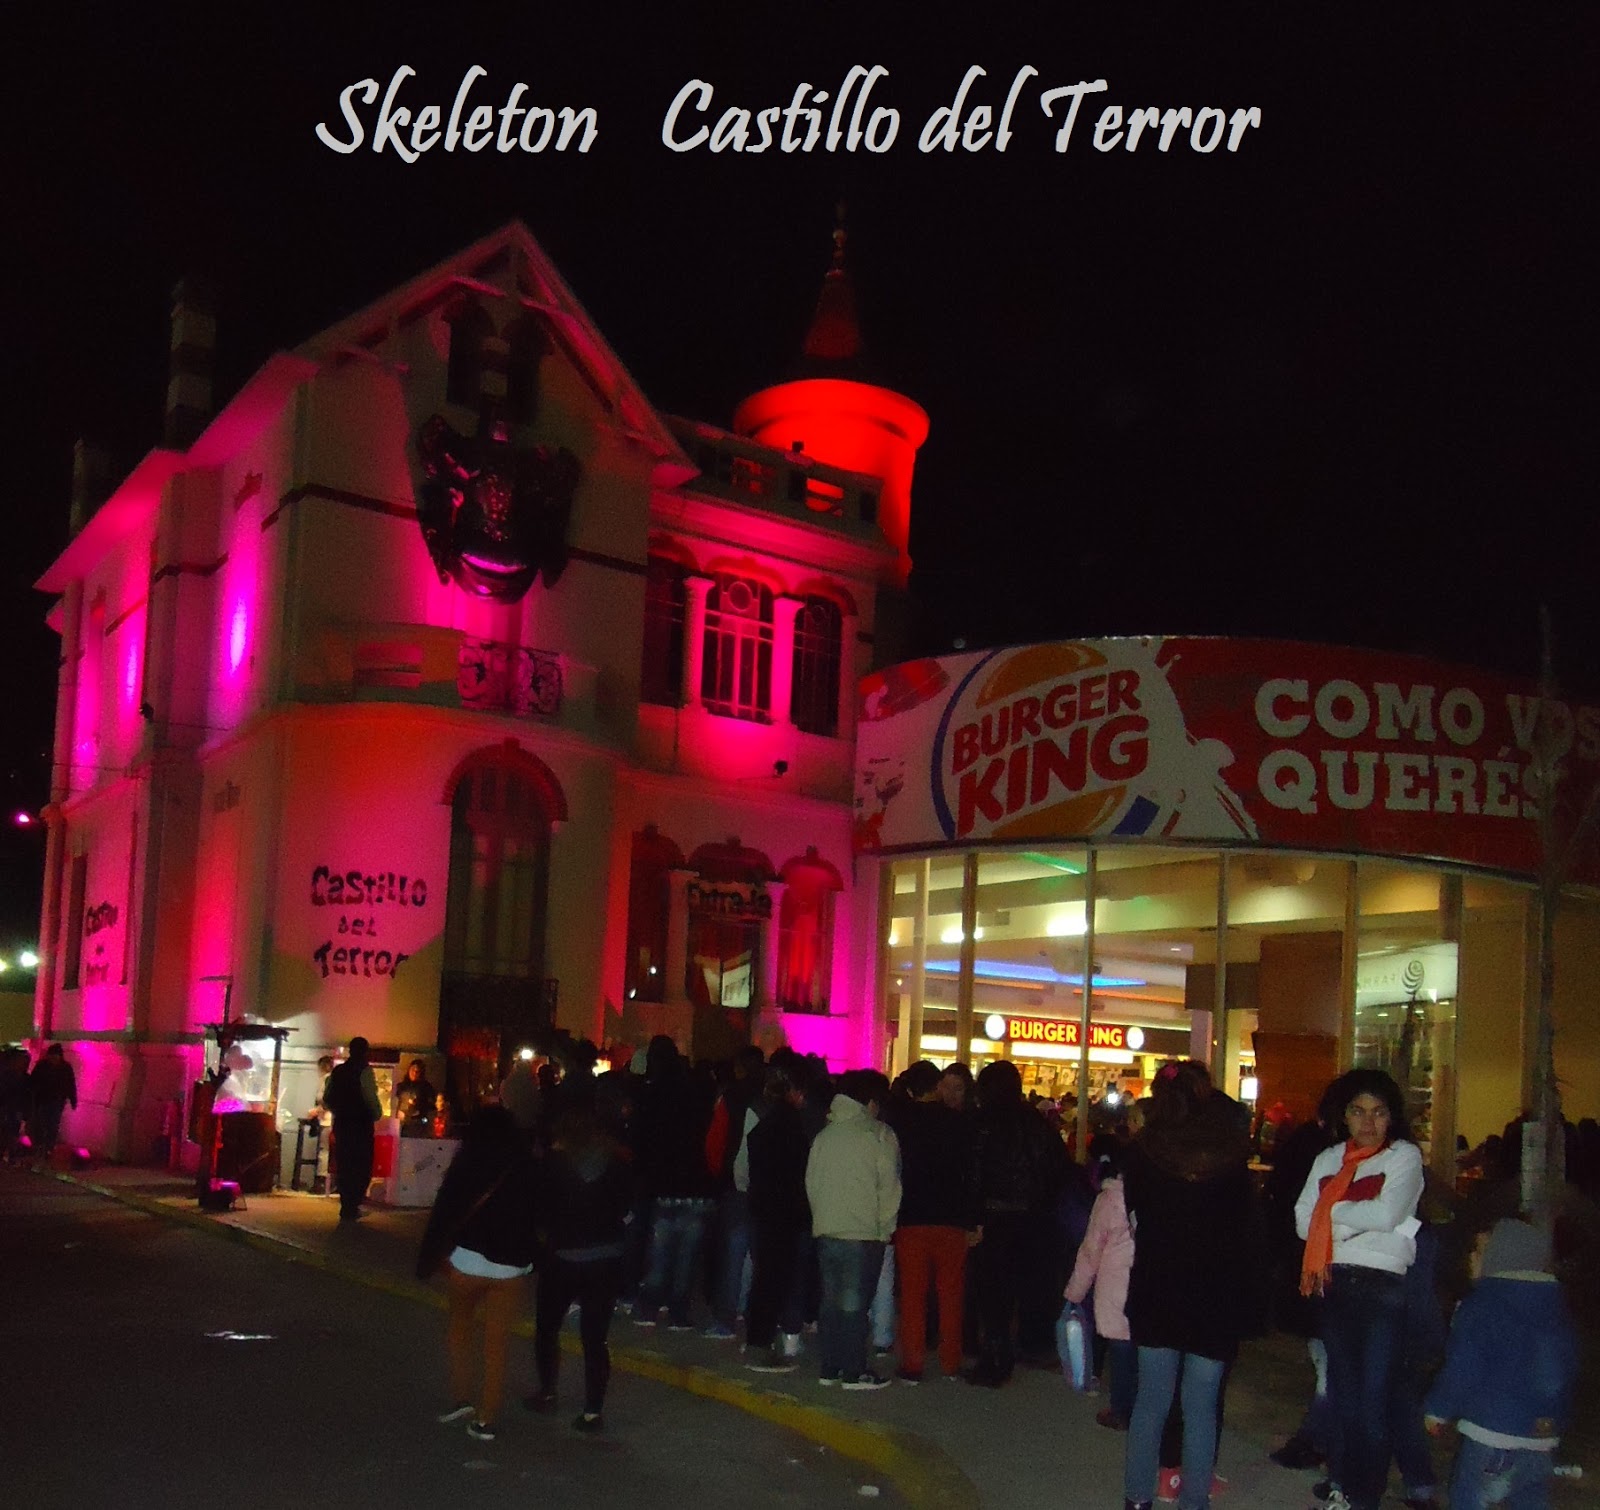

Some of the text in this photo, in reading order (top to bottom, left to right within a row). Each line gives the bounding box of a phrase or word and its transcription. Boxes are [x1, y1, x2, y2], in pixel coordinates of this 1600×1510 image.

[952, 669, 1142, 776] BURGER
[1254, 678, 1486, 745] COMO
[957, 714, 1150, 838] KING
[313, 940, 410, 979] Terror
[1009, 1019, 1123, 1047] BURGER ING
